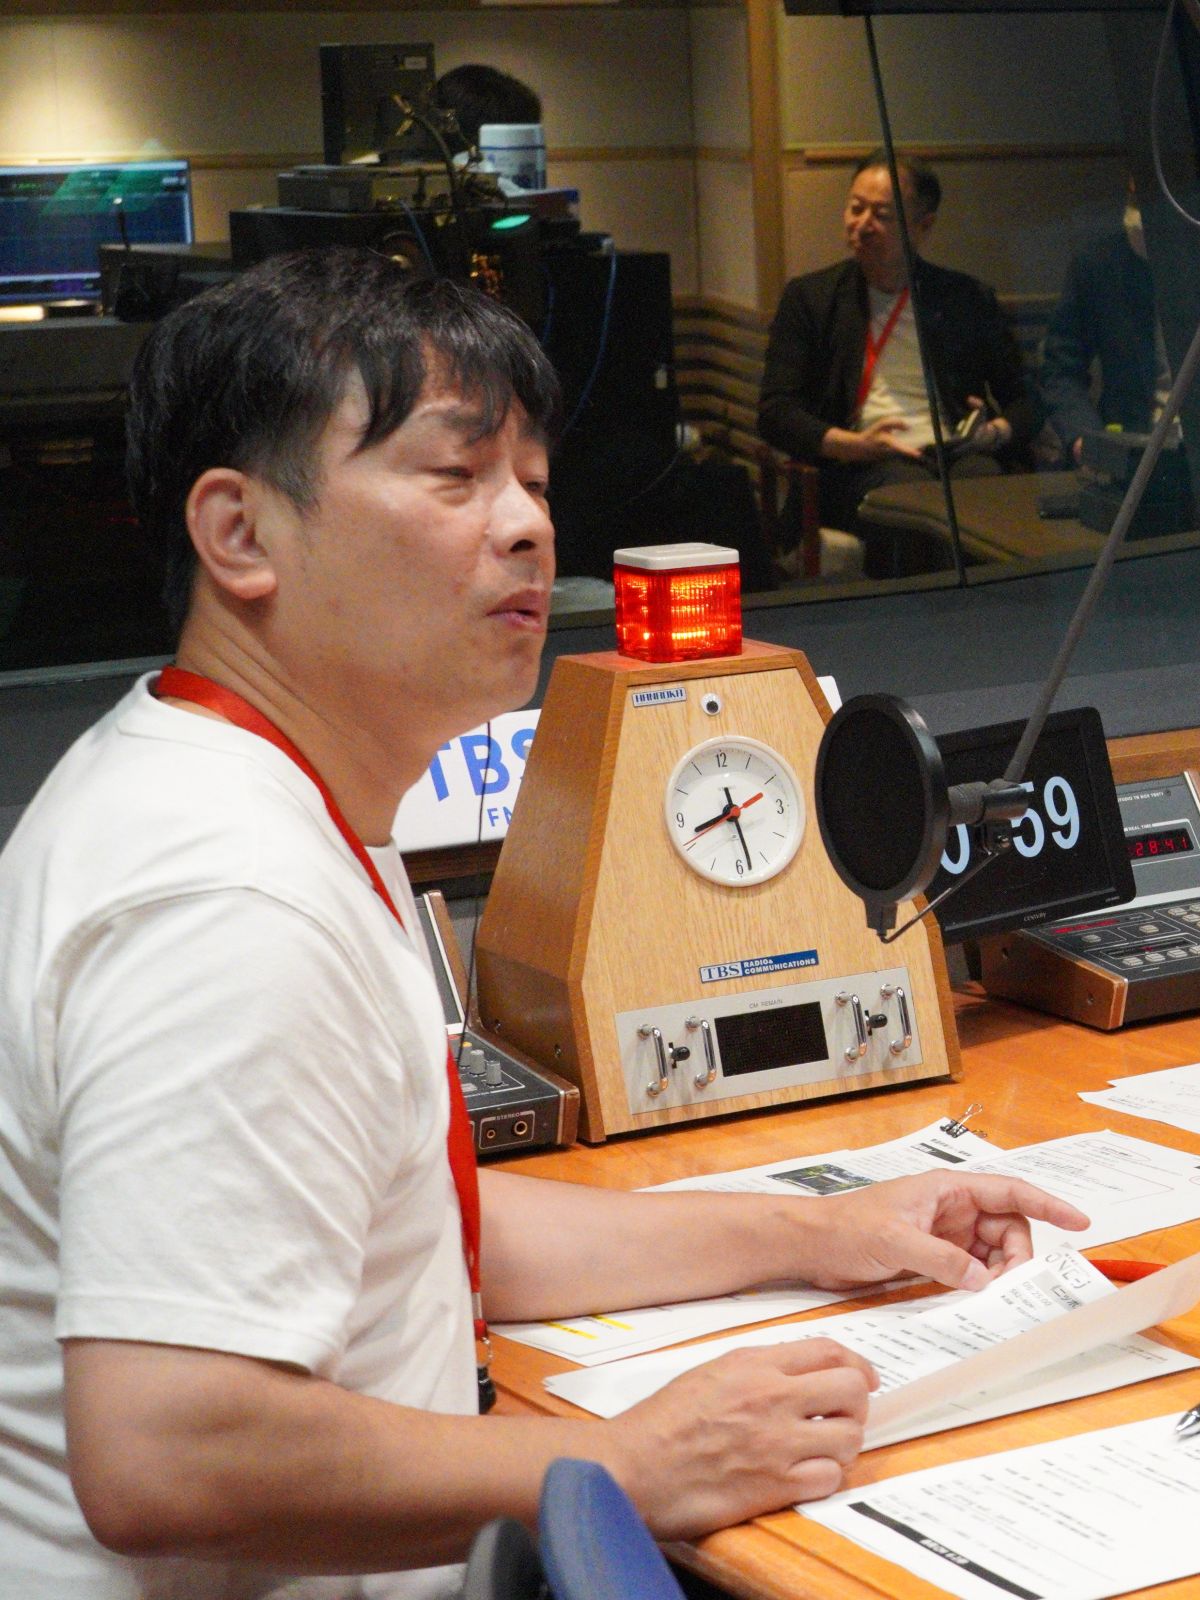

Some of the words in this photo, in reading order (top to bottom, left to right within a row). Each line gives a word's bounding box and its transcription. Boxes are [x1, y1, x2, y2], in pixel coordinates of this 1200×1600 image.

[716, 752, 728, 768] 12
[776, 798, 784, 814] 3
[676, 812, 685, 828] 9
[735, 859, 744, 875] 6
[702, 964, 740, 979] TBS
[744, 958, 816, 975] COMMUNICATIONS
[496, 1112, 520, 1121] STEREO
